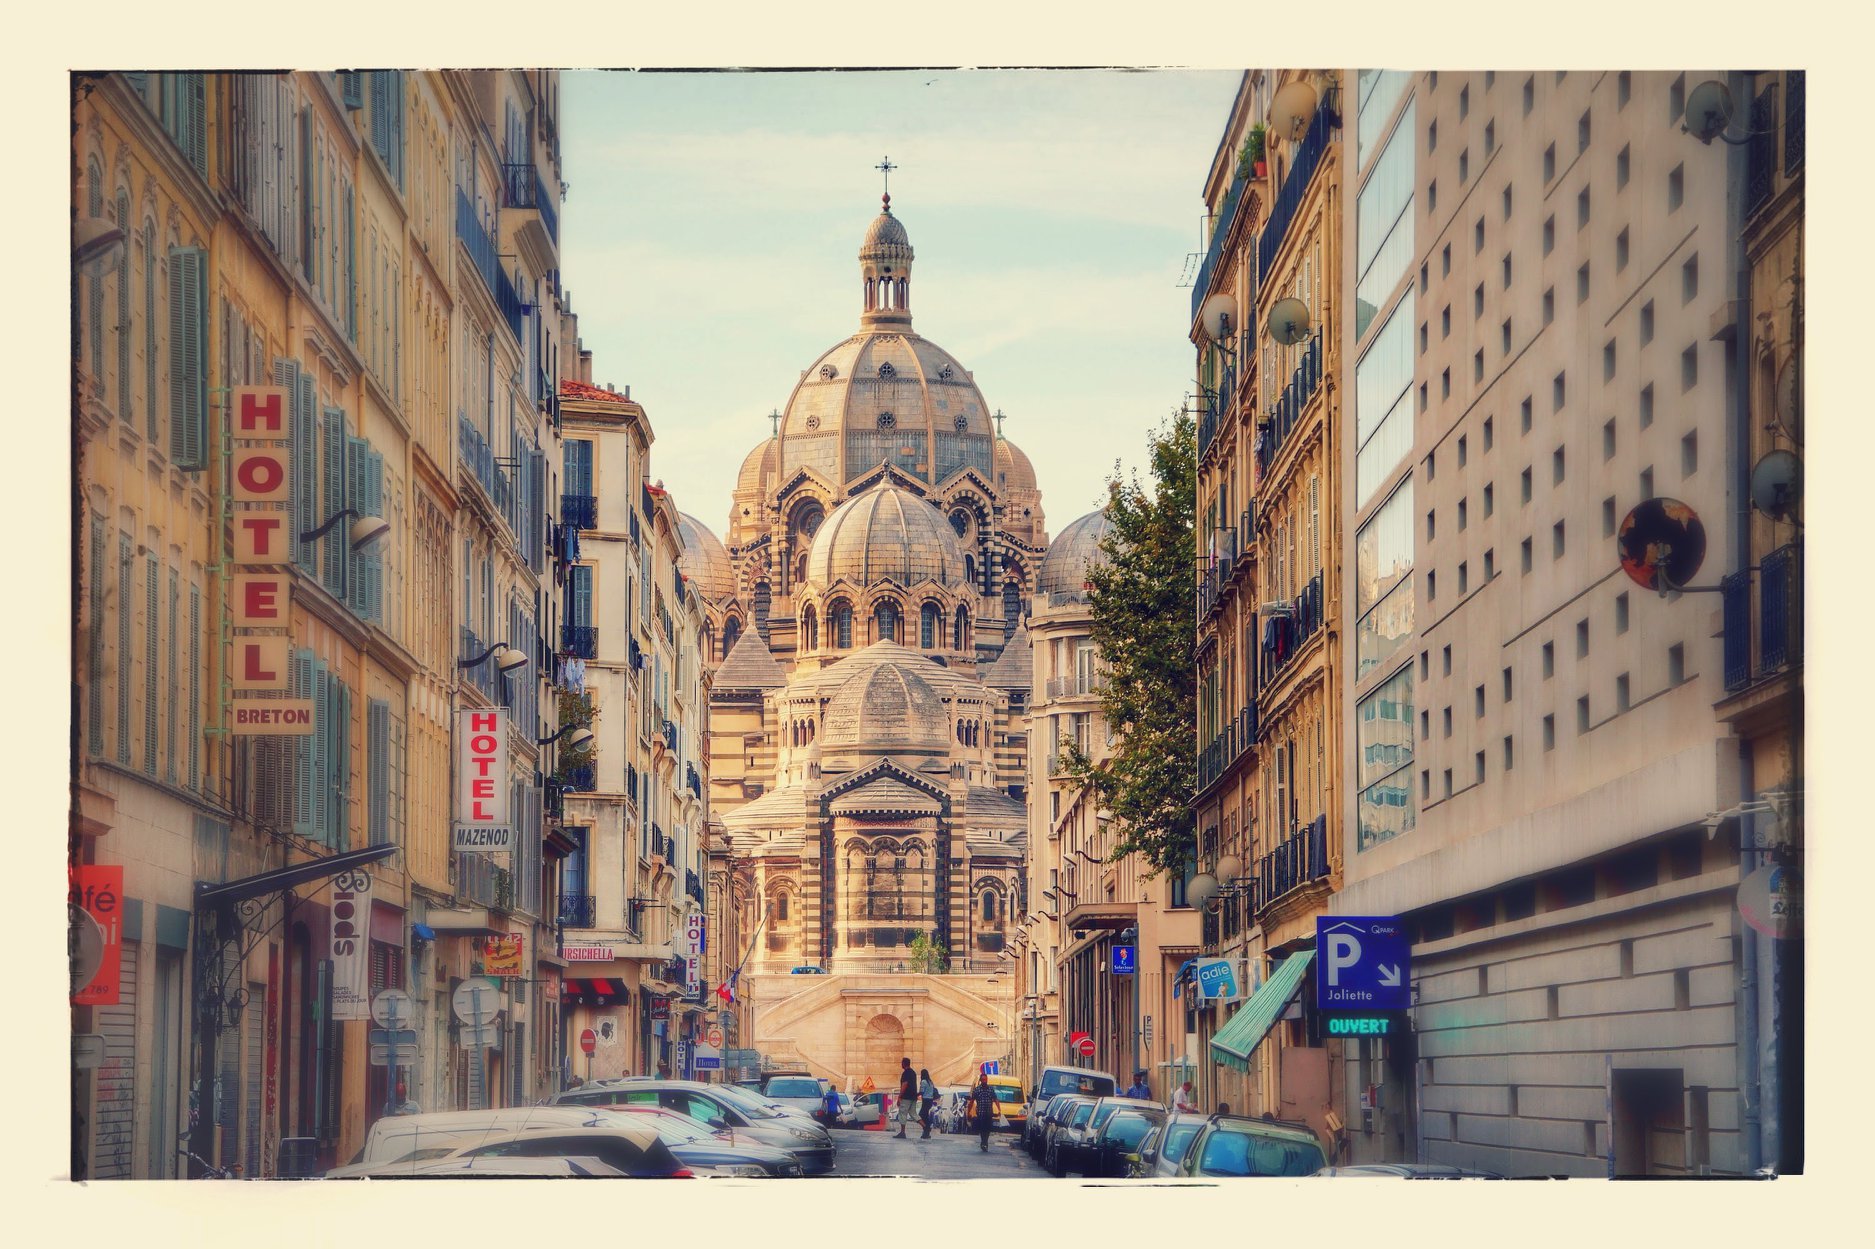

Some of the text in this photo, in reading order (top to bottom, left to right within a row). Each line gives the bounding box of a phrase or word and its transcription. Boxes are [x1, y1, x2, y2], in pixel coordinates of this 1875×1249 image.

[237, 393, 284, 681] HOTEL
[236, 709, 310, 725] BRETON
[470, 712, 498, 820] HOTEL
[456, 828, 509, 847] MAZENOD
[687, 915, 700, 983] HOTEL
[1327, 933, 1362, 986] P
[1201, 965, 1230, 981] adie
[1327, 988, 1373, 1001] Joliette
[1329, 1018, 1390, 1034] OUVERT
